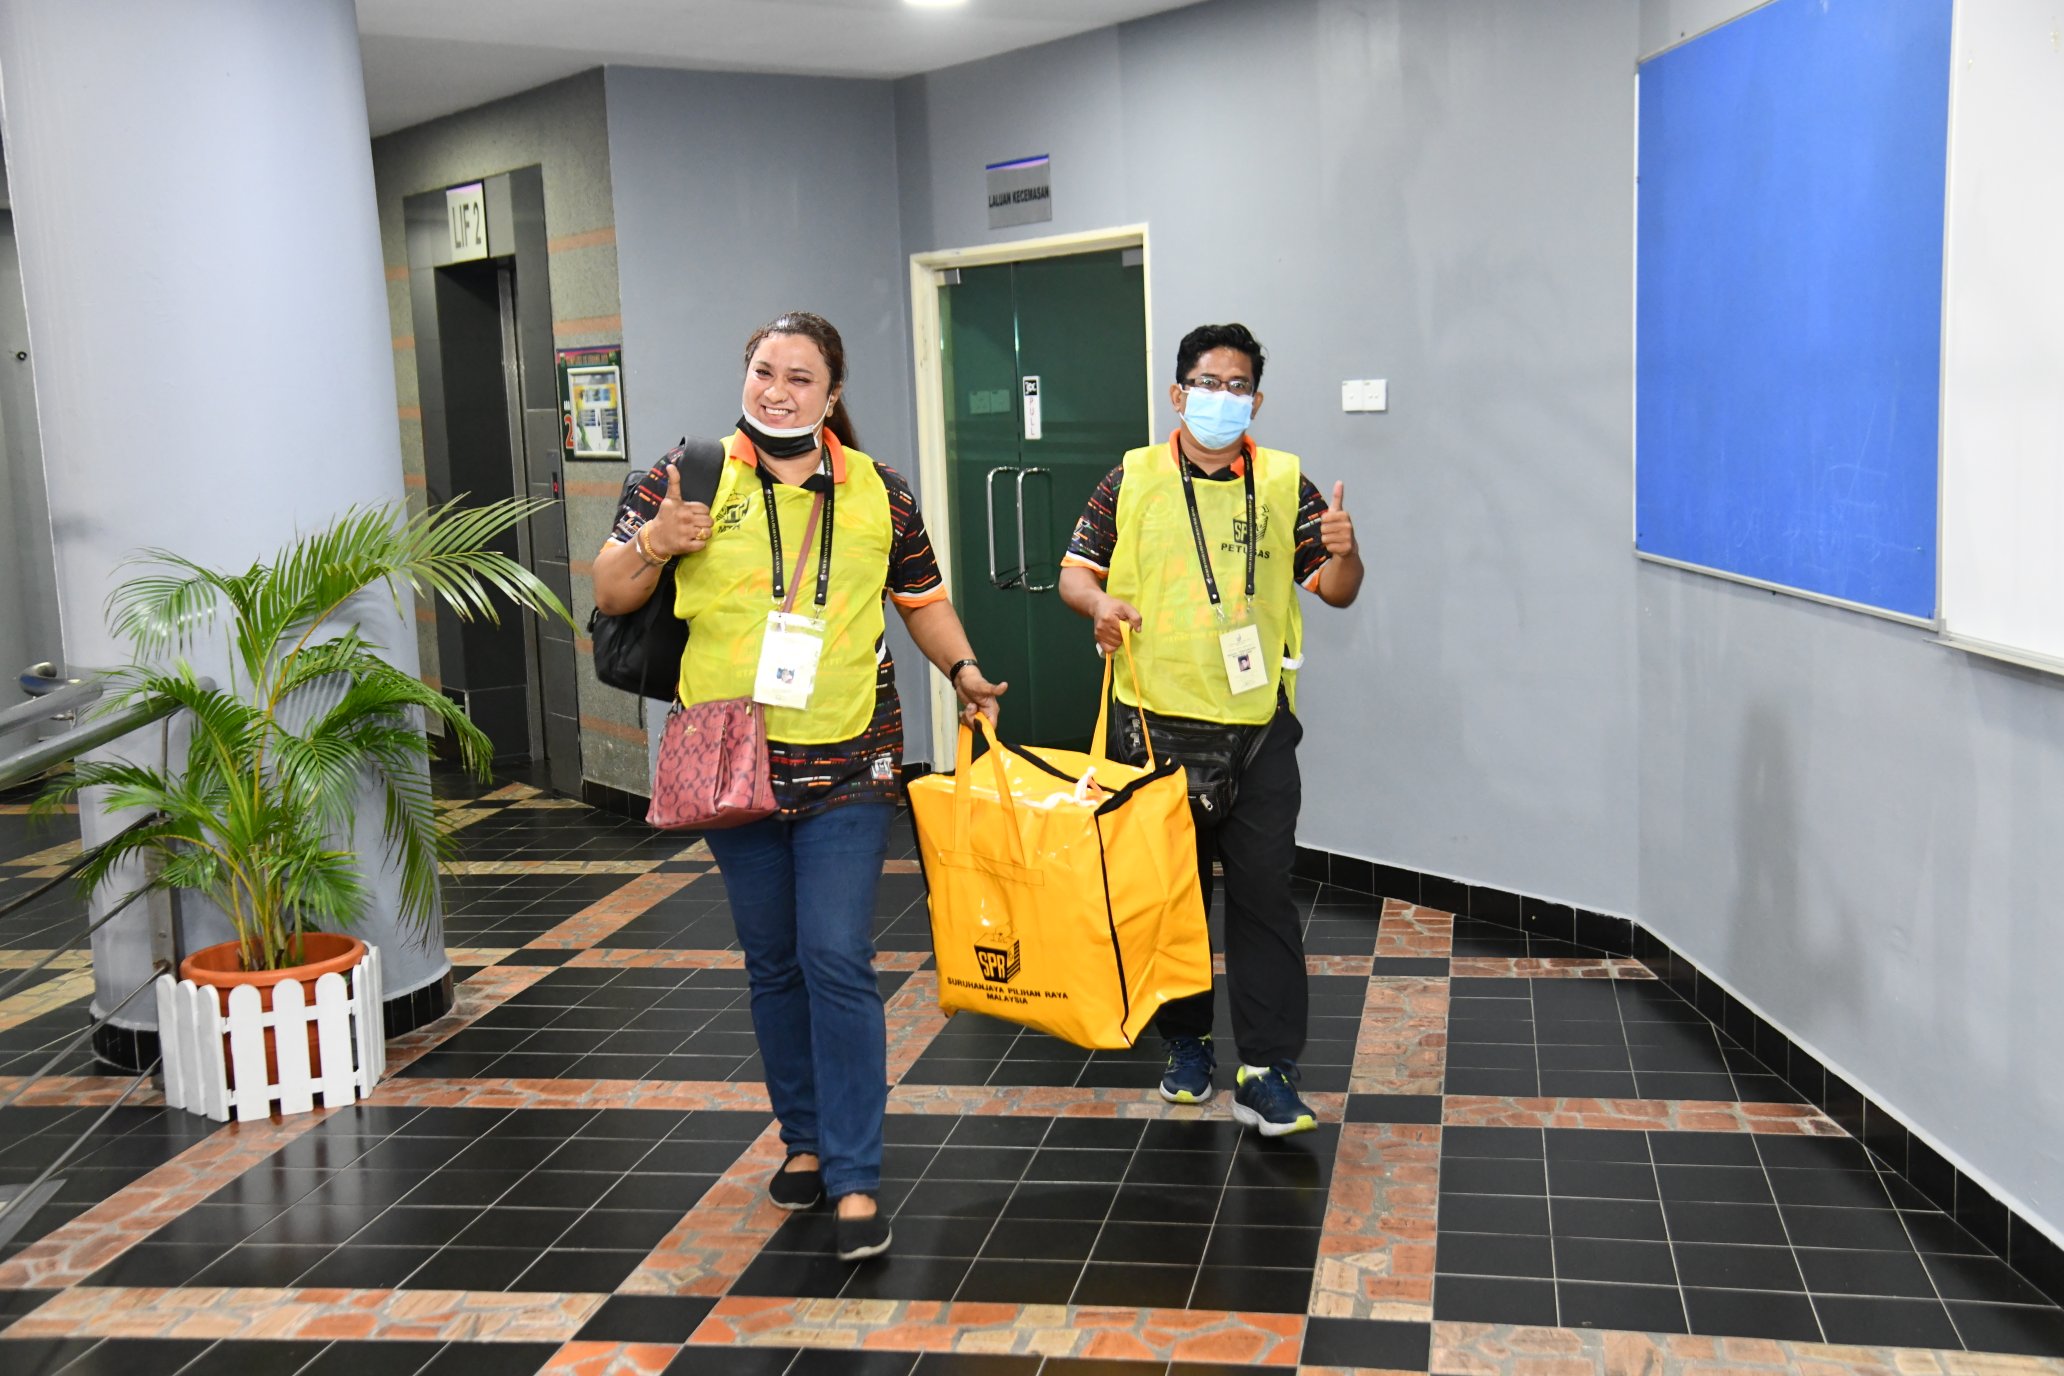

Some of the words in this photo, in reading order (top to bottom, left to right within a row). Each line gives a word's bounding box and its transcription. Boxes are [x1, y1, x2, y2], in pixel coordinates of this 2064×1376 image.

[988, 191, 1011, 208] LALUAN
[1012, 186, 1049, 203] KECEMASAN
[452, 203, 470, 248] LIF
[473, 202, 482, 245] 2
[1234, 522, 1248, 541] SP
[1221, 543, 1270, 559] PETUAS
[978, 951, 1005, 979] SPR
[947, 977, 1004, 993] SURUHANJAYA
[1007, 988, 1041, 997] PILIHAN
[1045, 991, 1069, 999] RAYA
[986, 993, 1028, 1004] MALAYSIA
